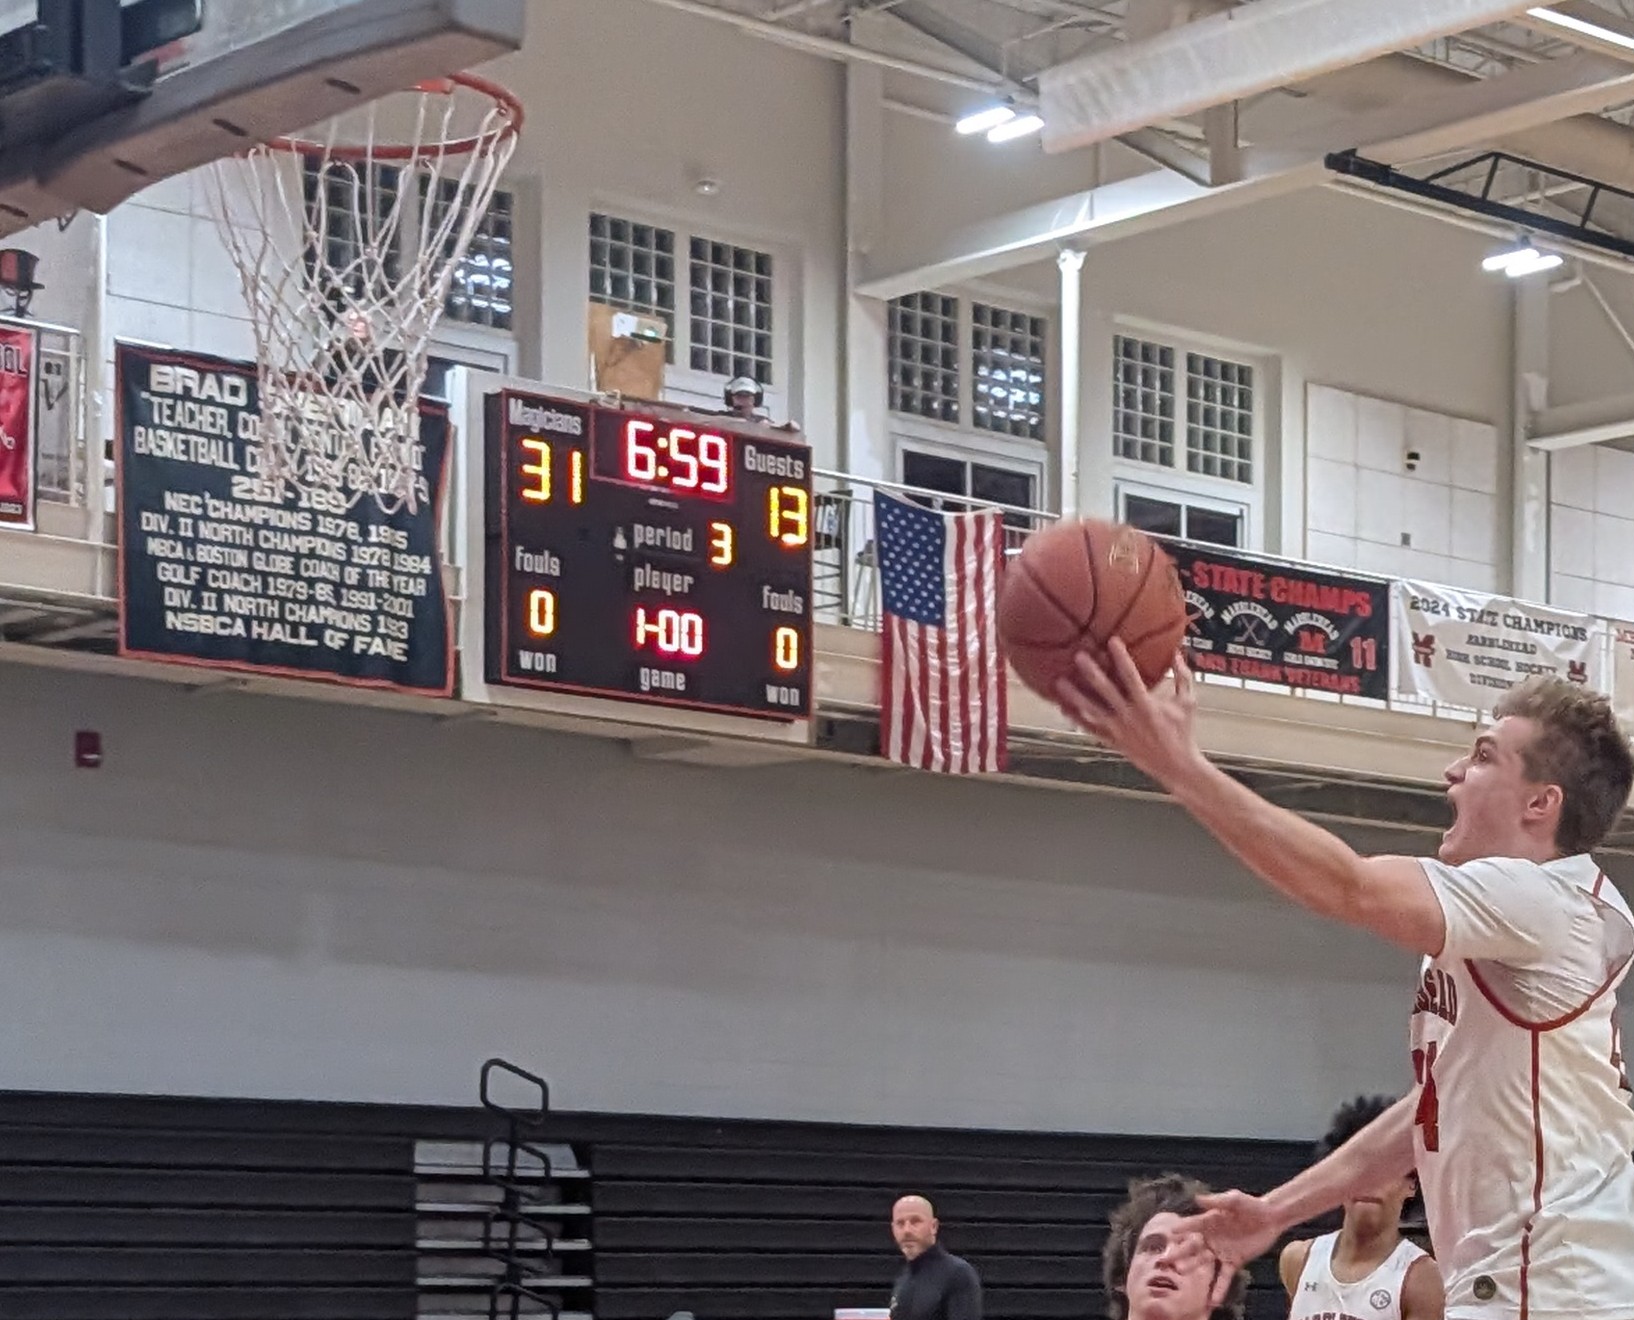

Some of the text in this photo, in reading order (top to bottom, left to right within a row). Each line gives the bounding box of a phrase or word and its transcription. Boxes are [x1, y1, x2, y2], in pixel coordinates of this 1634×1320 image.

[150, 363, 248, 406] BRAD
[134, 425, 240, 470] BASKETBALL
[626, 420, 729, 494] 6:59
[744, 444, 805, 480] Guests
[520, 438, 583, 504] 31
[164, 490, 203, 516] NEC
[206, 498, 312, 531] CHAMPIONS
[768, 486, 809, 546] 13
[141, 511, 175, 535] DIV.
[178, 517, 194, 538] II
[198, 519, 254, 547] NORTH
[392, 551, 432, 575] 1984
[633, 522, 693, 552] period
[711, 522, 733, 566] 3
[156, 560, 203, 586] GOLF
[206, 568, 263, 594] COACH
[196, 543, 249, 568] BOSTON
[252, 551, 296, 576] GLOBE
[344, 566, 362, 585] OF
[366, 568, 391, 589] THE
[633, 564, 694, 593] player
[163, 586, 198, 610] DIV.
[201, 591, 219, 612] II
[223, 593, 280, 619] NORTH
[1193, 561, 1373, 618] STATE CHAMPS
[165, 610, 248, 639] NSBCA
[250, 619, 319, 647] HALL
[322, 628, 350, 651] OF
[529, 589, 555, 635] 0
[1410, 594, 1588, 642] 2024 STATE CHAMPIONS
[519, 650, 557, 673] won
[775, 626, 799, 670] 0
[1350, 635, 1377, 671] 11
[639, 666, 686, 692] game
[766, 684, 800, 706] won
